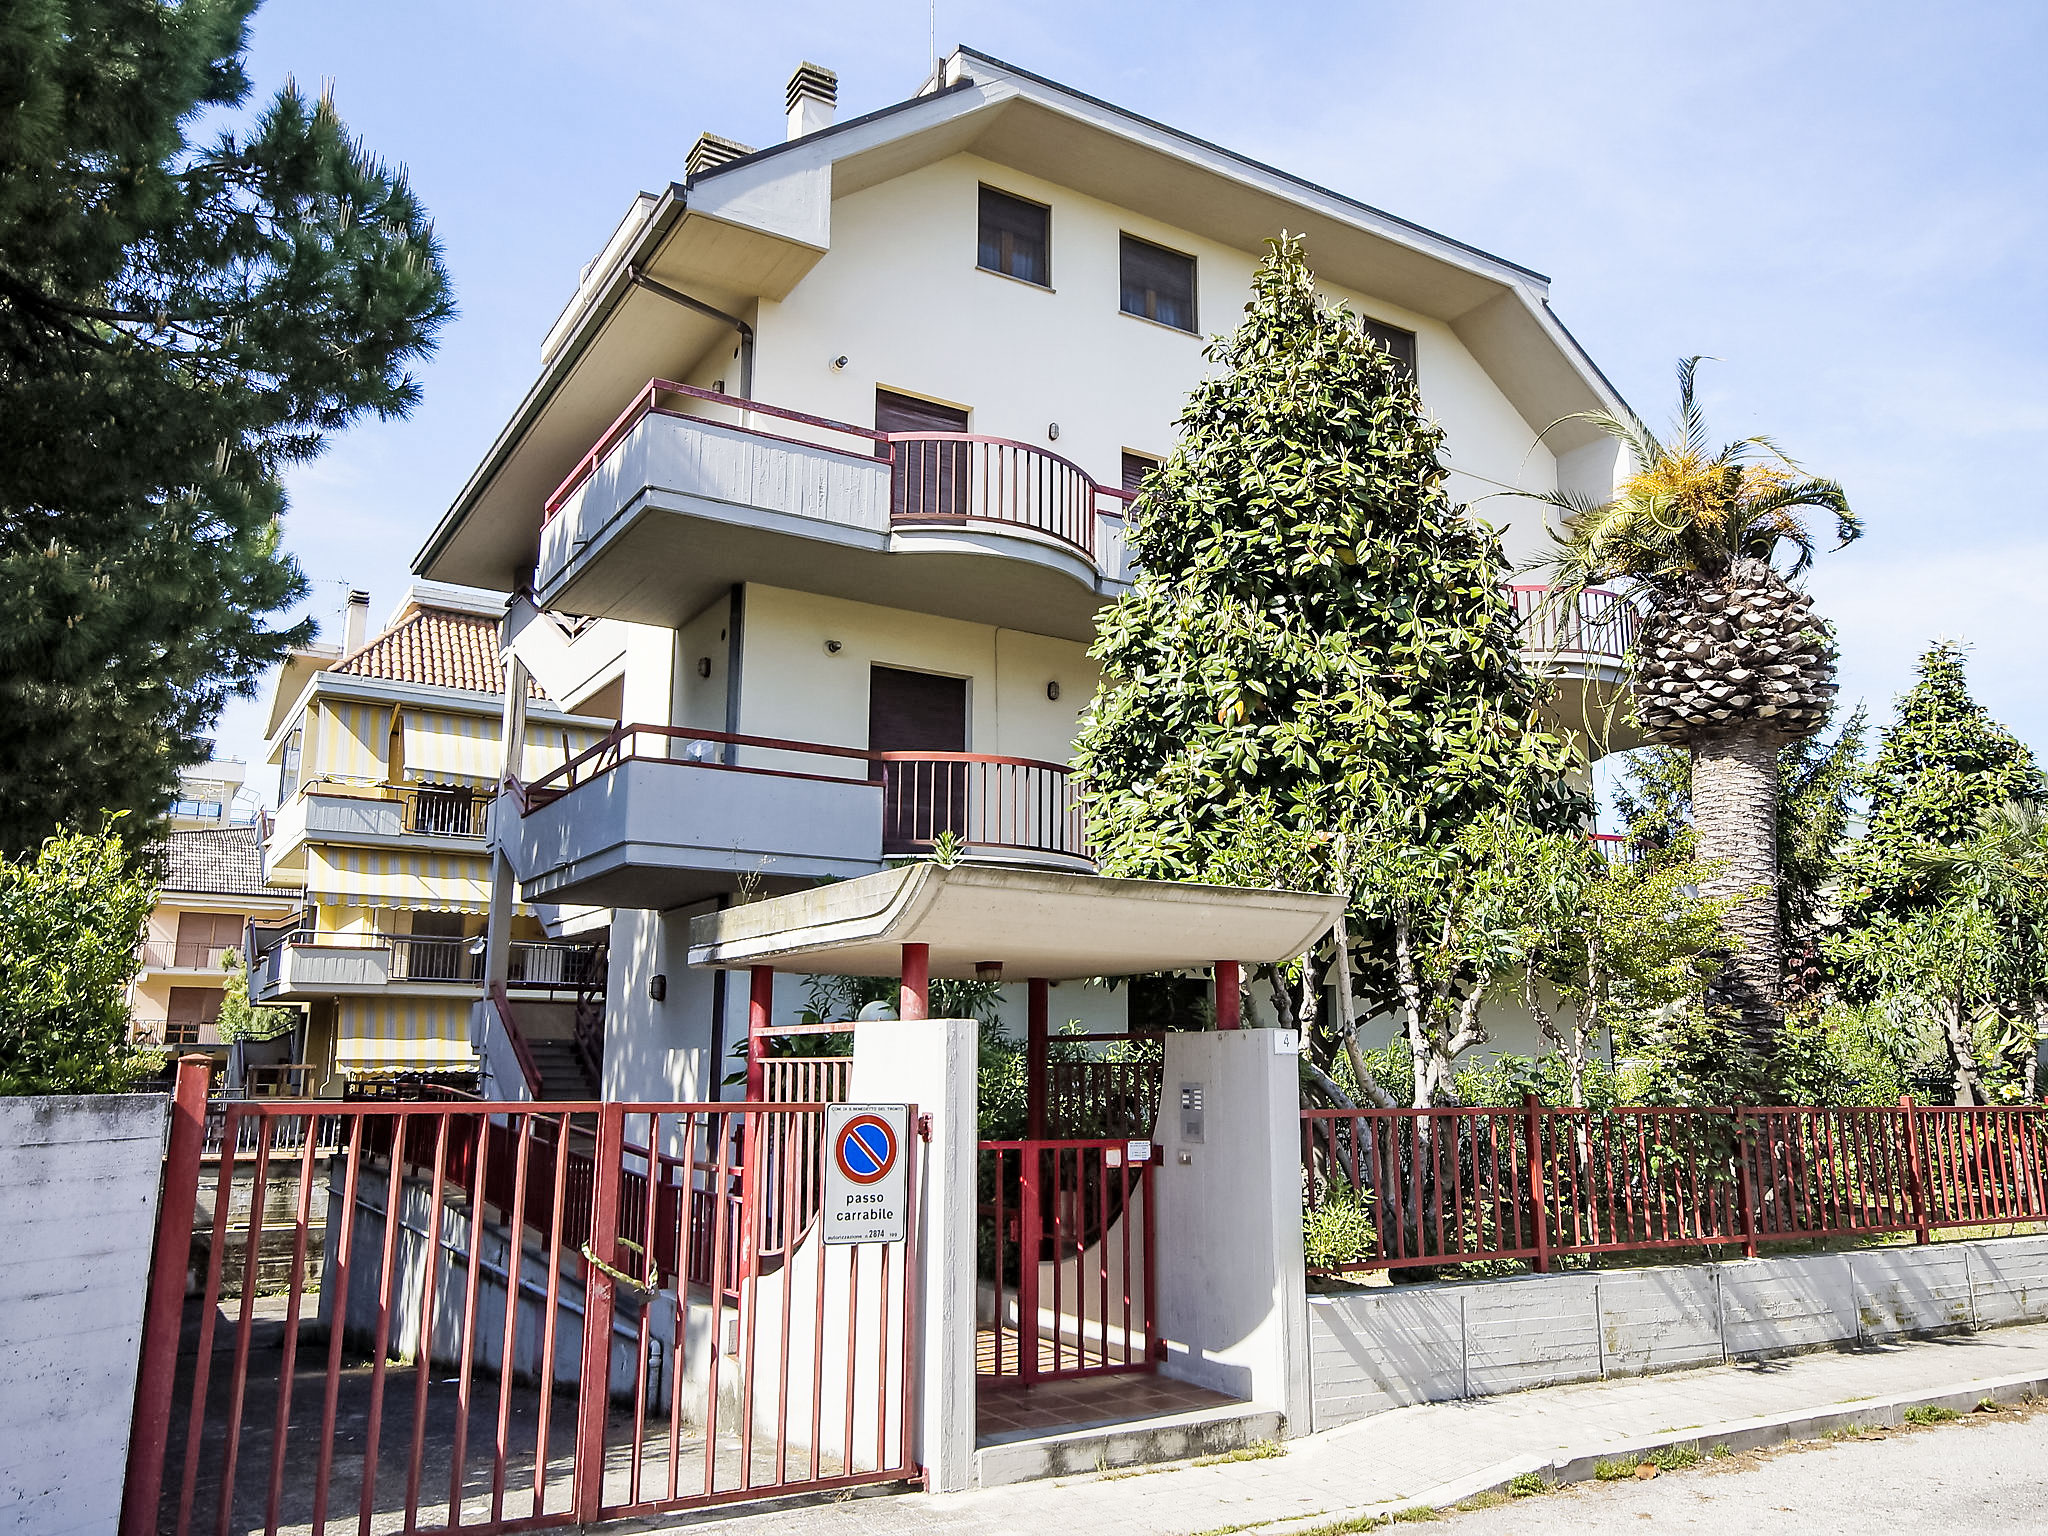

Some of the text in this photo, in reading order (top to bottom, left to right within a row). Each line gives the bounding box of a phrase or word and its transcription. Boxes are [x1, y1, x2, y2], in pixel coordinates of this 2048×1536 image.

[1283, 1033, 1290, 1048] 4
[846, 1194, 884, 1207] passo
[836, 1208, 894, 1221] carrabile
[868, 1229, 885, 1239] 2874
